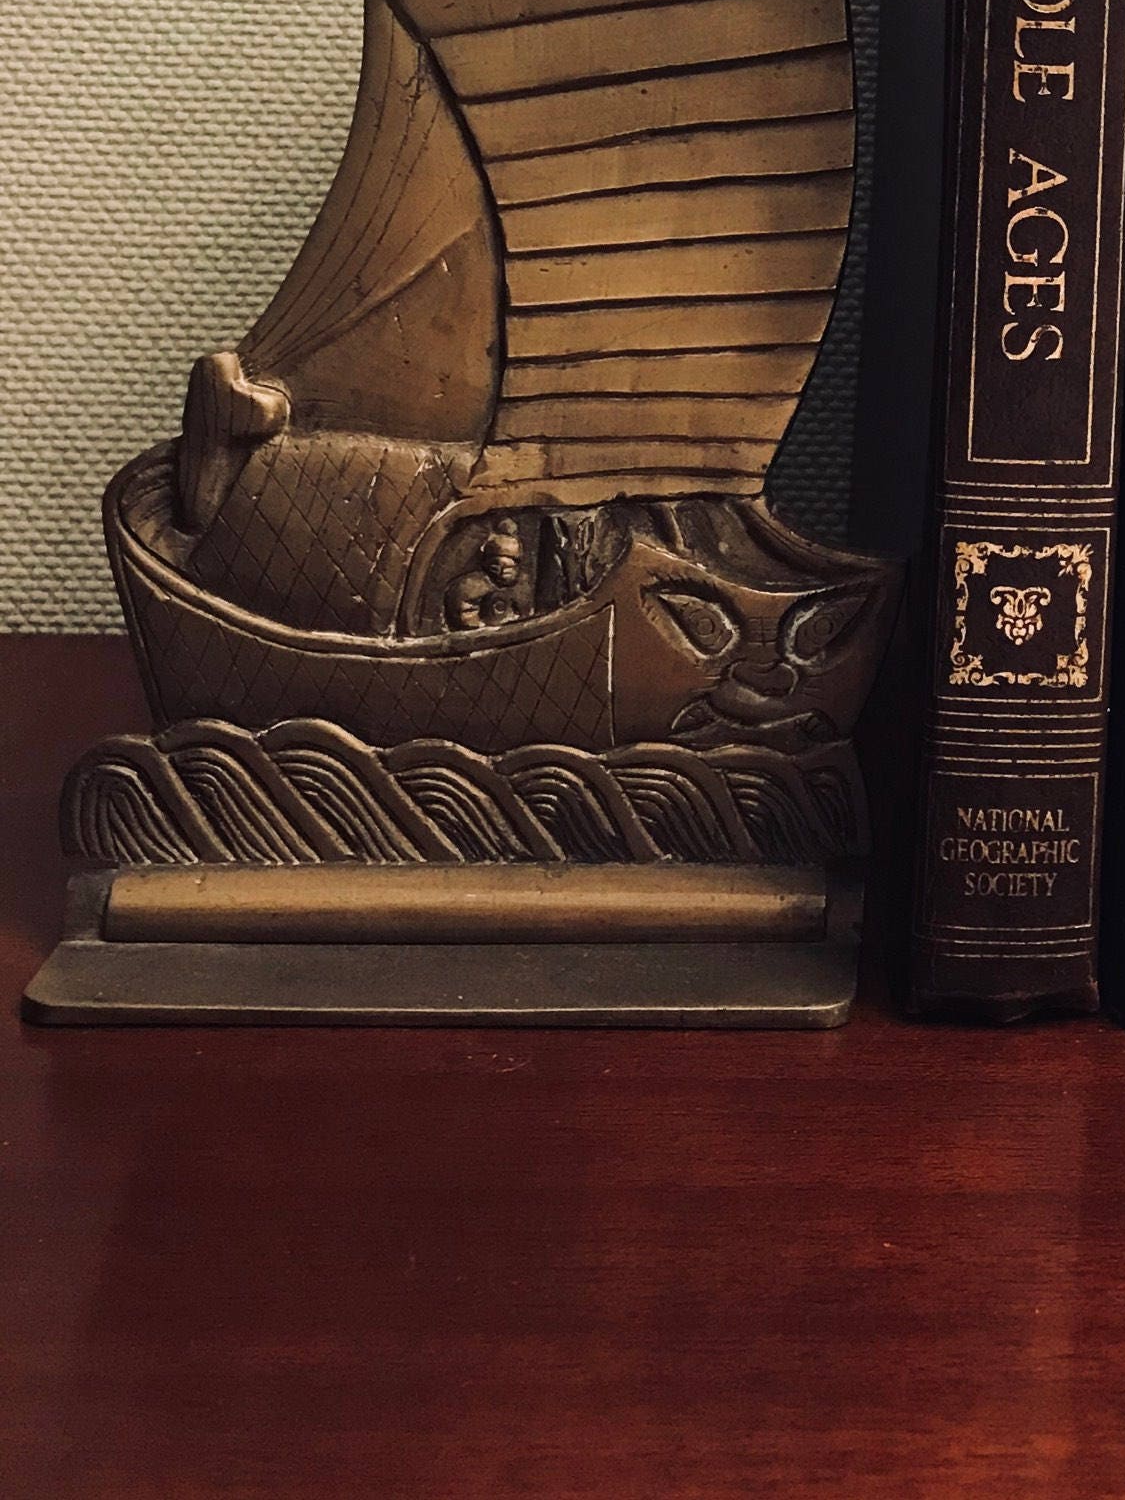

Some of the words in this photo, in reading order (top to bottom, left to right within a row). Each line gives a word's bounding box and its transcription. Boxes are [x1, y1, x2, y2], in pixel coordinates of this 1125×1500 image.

[1001, 148, 1070, 363] AGES
[957, 807, 1070, 833] NATIONAL
[940, 837, 1081, 864] GEOGRAPHIC
[964, 872, 1058, 897] SOCIETY
